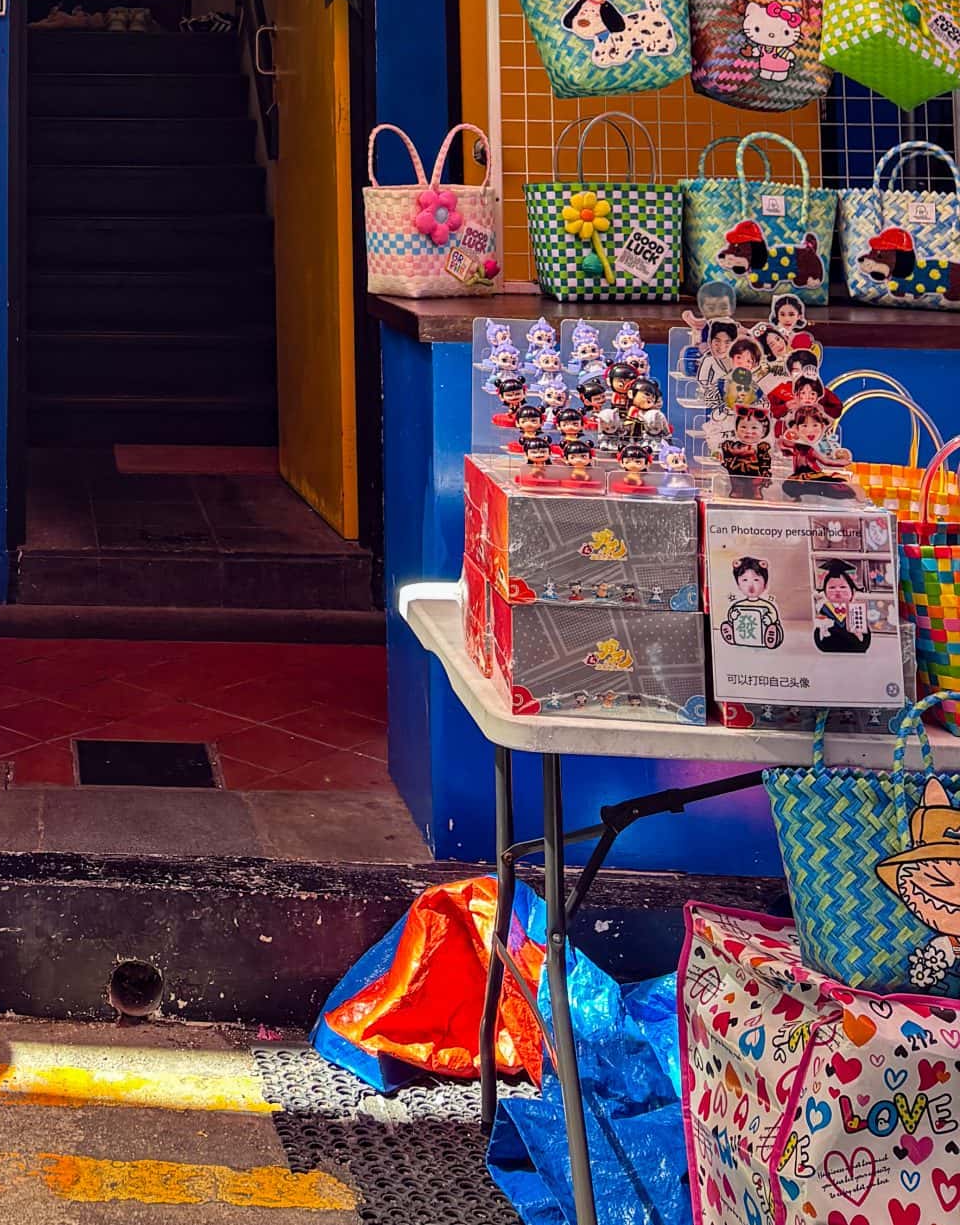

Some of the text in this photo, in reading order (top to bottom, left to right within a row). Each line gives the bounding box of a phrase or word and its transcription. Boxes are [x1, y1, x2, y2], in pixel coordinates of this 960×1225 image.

[462, 235, 487, 254] LUCK
[466, 227, 489, 243] GOOD
[633, 232, 665, 254] GOOD
[626, 240, 659, 264] LUCK
[710, 525, 728, 534] Can
[731, 526, 783, 538] Photocopy
[786, 528, 826, 538] personal
[737, 614, 759, 642] 發
[727, 674, 810, 688] 可以打印自己头像
[839, 1092, 959, 1137] LOVE
